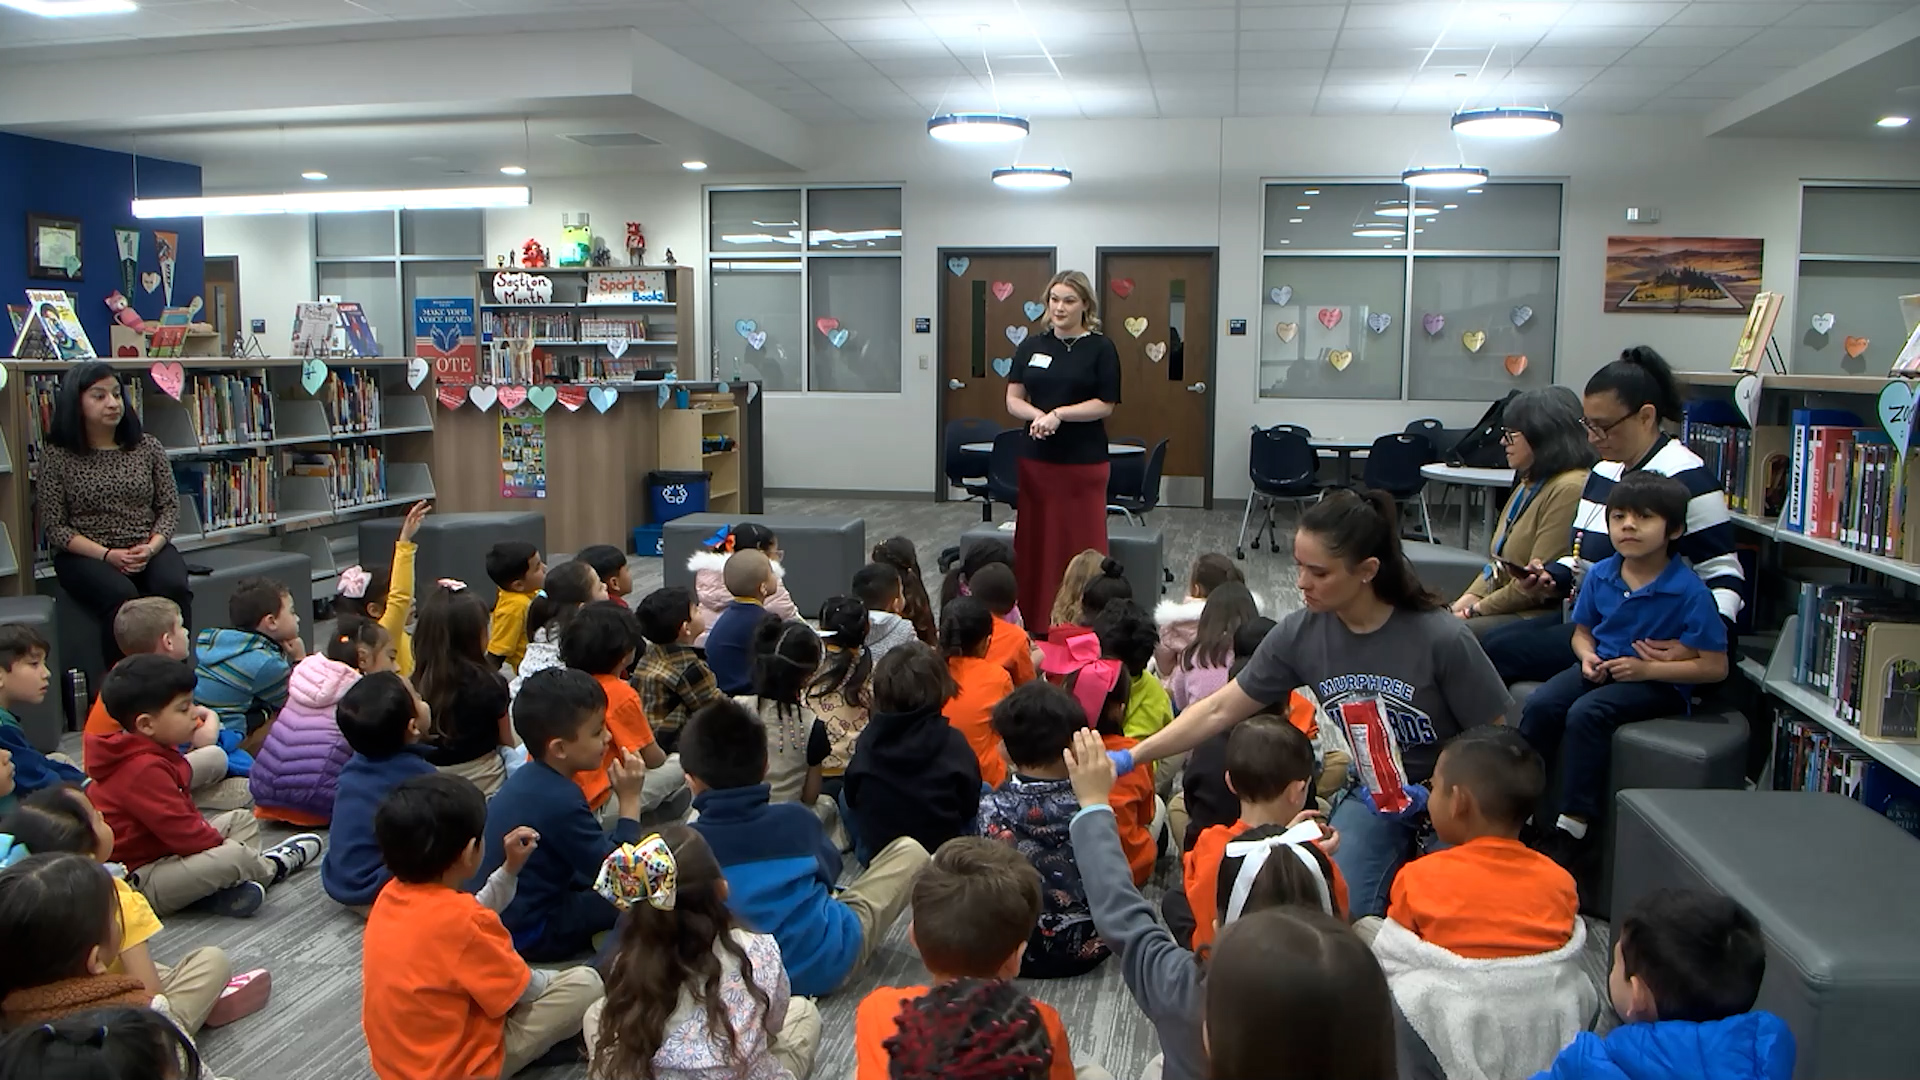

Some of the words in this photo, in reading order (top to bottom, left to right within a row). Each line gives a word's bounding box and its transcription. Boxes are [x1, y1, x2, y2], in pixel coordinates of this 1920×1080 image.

[496, 272, 547, 291] Section
[599, 275, 646, 294] Sports
[504, 290, 545, 304] Month
[632, 289, 664, 302] Books
[419, 316, 444, 324] VOICE
[445, 316, 472, 324] HEARD
[434, 357, 472, 373] OTE
[1319, 674, 1415, 701] MURPHREE
